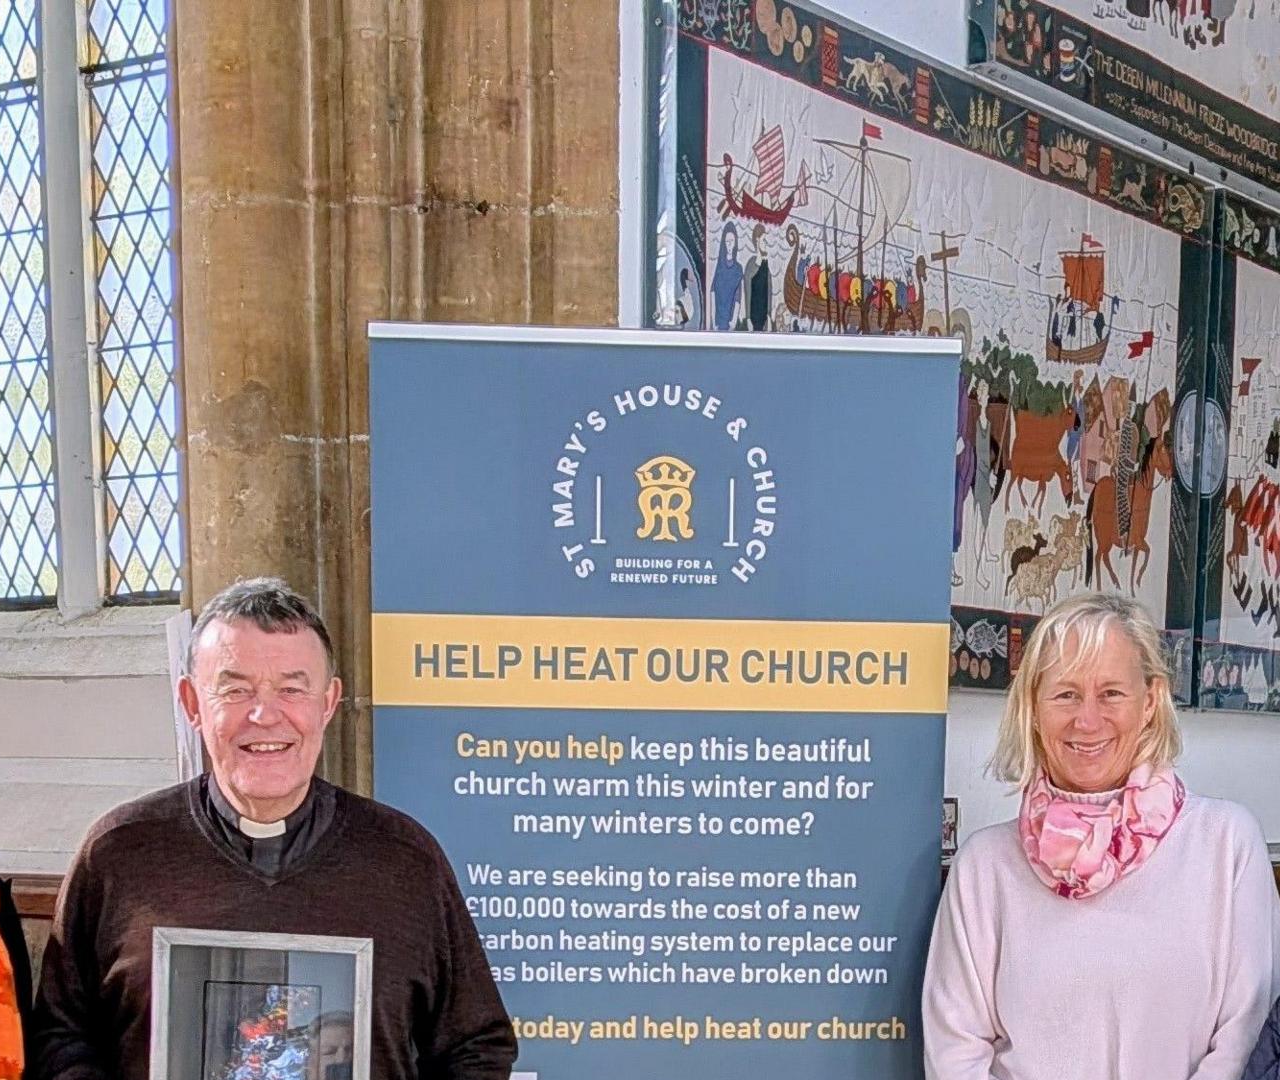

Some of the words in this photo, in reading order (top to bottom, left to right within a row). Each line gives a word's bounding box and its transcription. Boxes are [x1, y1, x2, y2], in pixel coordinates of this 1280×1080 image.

[614, 385, 721, 418] HOUSE
[727, 417, 747, 441] &
[553, 411, 607, 527] MARY'S
[731, 447, 776, 582] CHURCH
[562, 543, 595, 578] ST
[616, 559, 672, 568] BUILDING
[677, 560, 700, 569] FOR
[705, 560, 712, 569] A
[611, 573, 668, 583] RENEWED
[673, 574, 717, 584] FUTURE
[415, 644, 522, 679] HELP
[534, 646, 638, 681] HEAT
[647, 648, 729, 682] OUR
[742, 650, 907, 685] CHURCH
[458, 733, 507, 757] Can
[514, 741, 560, 764] you
[568, 735, 623, 765] help
[631, 736, 693, 766] keep
[700, 737, 748, 760] this
[756, 738, 870, 762] beautiful
[455, 771, 545, 795] church
[553, 779, 628, 796] warm
[636, 774, 684, 797] this
[692, 775, 776, 798] winter
[783, 776, 829, 798] and
[836, 776, 873, 799] for
[514, 815, 585, 839] many
[591, 810, 692, 833] winters
[698, 813, 723, 834] to
[730, 812, 814, 835] come?
[467, 864, 502, 885] We
[509, 870, 546, 885] are
[553, 866, 642, 891] seeking
[649, 868, 670, 886] to
[677, 867, 734, 887] raise
[741, 873, 800, 887] more
[806, 868, 856, 888] than
[466, 897, 564, 919] £100,000
[571, 899, 666, 918] towards
[672, 899, 707, 919] the
[714, 901, 761, 919] cost
[768, 900, 789, 919] of
[794, 905, 806, 919] a
[814, 905, 860, 920] new
[560, 930, 644, 955] heating
[651, 932, 733, 956] system
[740, 933, 761, 951] to
[768, 932, 852, 956] replace
[859, 937, 897, 952] our
[490, 967, 515, 981] as
[522, 962, 602, 982] boilers
[608, 962, 675, 982] which
[682, 963, 735, 983] have
[742, 963, 820, 983] broken
[827, 963, 887, 983] down
[512, 1016, 584, 1044] today
[590, 1016, 636, 1038] and
[644, 1016, 698, 1044] help
[706, 1017, 761, 1039] heat
[768, 1023, 812, 1039] our
[817, 1017, 904, 1039] church
